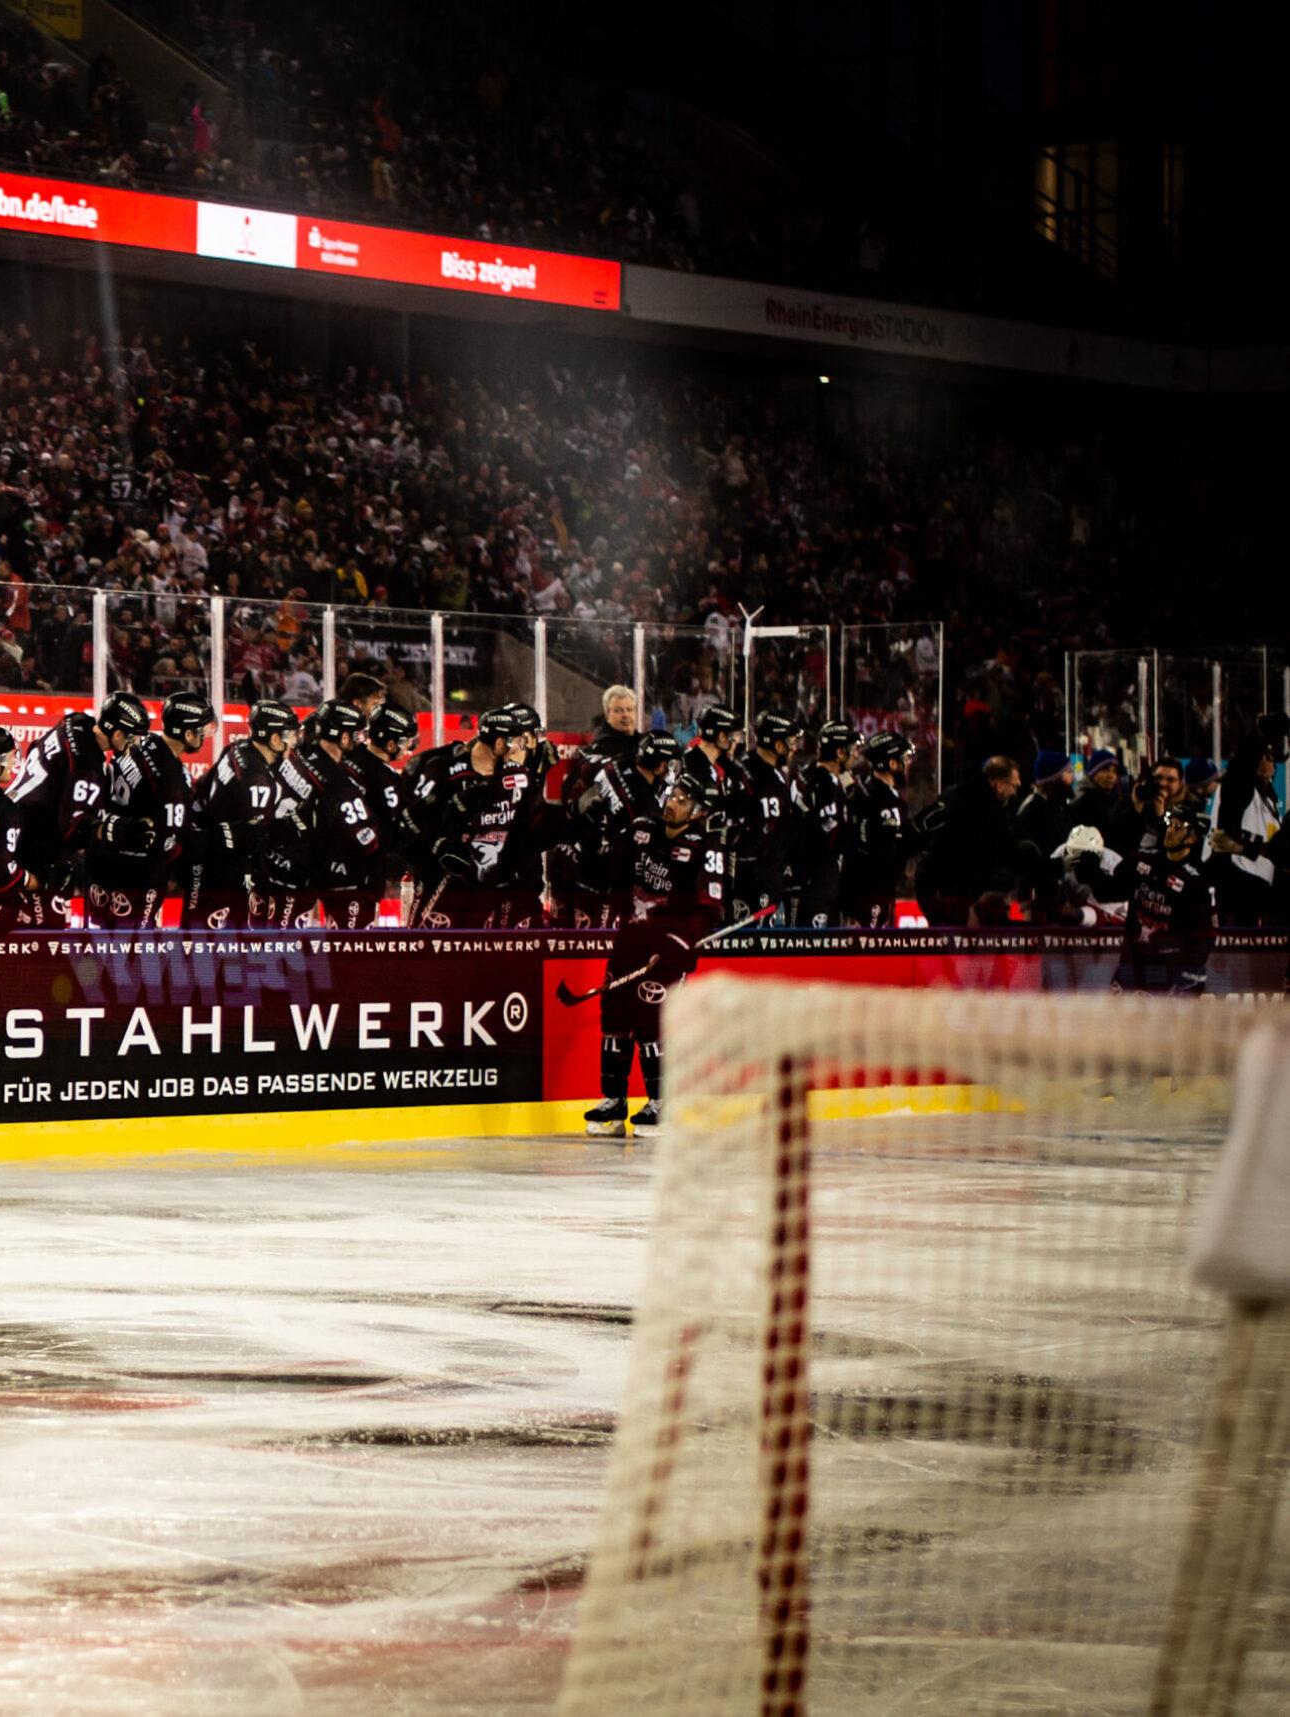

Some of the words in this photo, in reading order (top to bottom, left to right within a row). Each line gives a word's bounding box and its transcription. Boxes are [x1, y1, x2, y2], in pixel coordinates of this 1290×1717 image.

[441, 251, 476, 281] Biss
[478, 258, 536, 292] zeigen!
[72, 779, 101, 806] 67
[250, 785, 270, 808] 17
[384, 786, 399, 808] 5
[165, 803, 186, 828] 18
[340, 797, 368, 825] 39
[760, 797, 782, 819] 13
[4, 1077, 52, 1104] FÜR
[60, 1080, 140, 1101] JEDEN
[148, 1077, 195, 1098] JOB
[203, 1075, 250, 1096] DAS
[257, 1071, 377, 1095] PASSENDE
[383, 1068, 498, 1090] WERKZEUG
